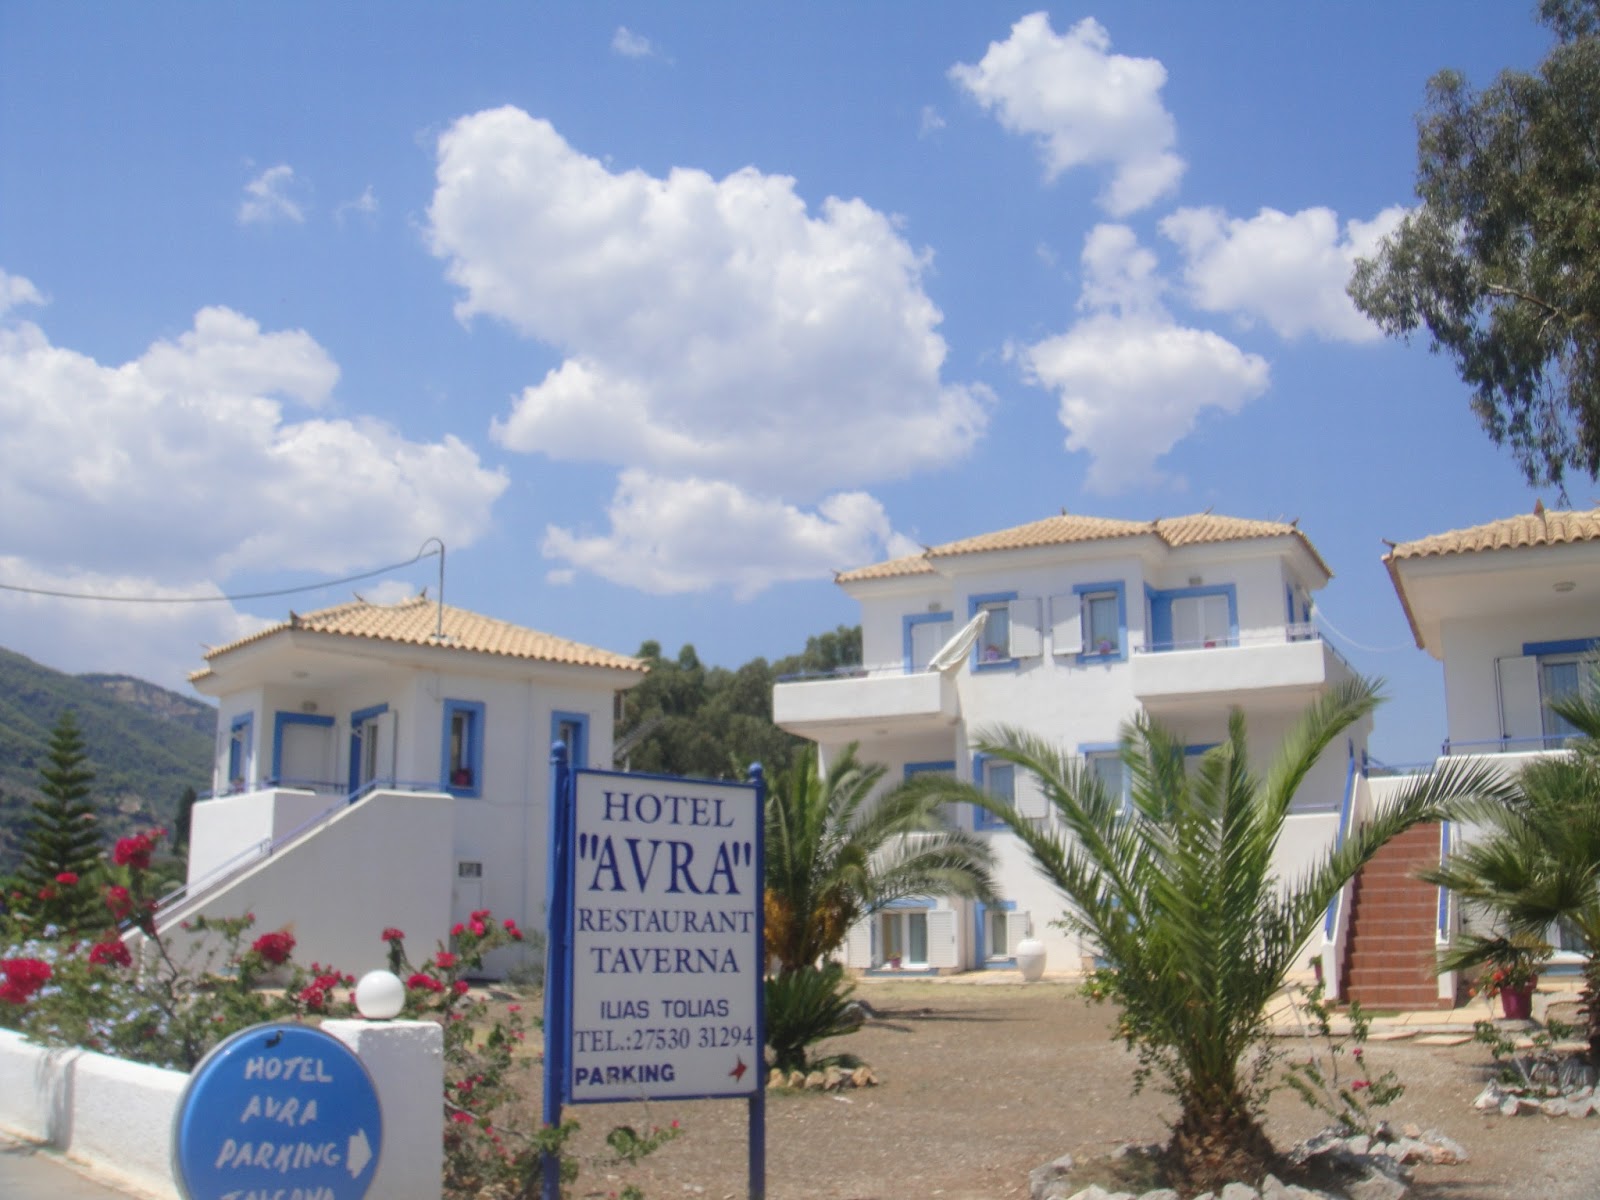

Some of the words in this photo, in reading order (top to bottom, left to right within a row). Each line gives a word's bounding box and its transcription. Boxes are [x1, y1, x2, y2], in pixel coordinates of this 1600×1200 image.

[602, 791, 735, 828] HOTEL
[579, 832, 752, 895] "AVRA"
[576, 907, 755, 934] RESTAURANT
[590, 946, 741, 974] TAVERNA
[601, 1000, 650, 1020] ILIAS
[661, 999, 729, 1019] TOLIAS
[698, 1025, 754, 1048] 31294
[244, 1056, 333, 1083] HOTEL
[575, 1063, 676, 1087] PARKING
[240, 1095, 318, 1127] AVRA
[214, 1138, 341, 1174] PARKING
